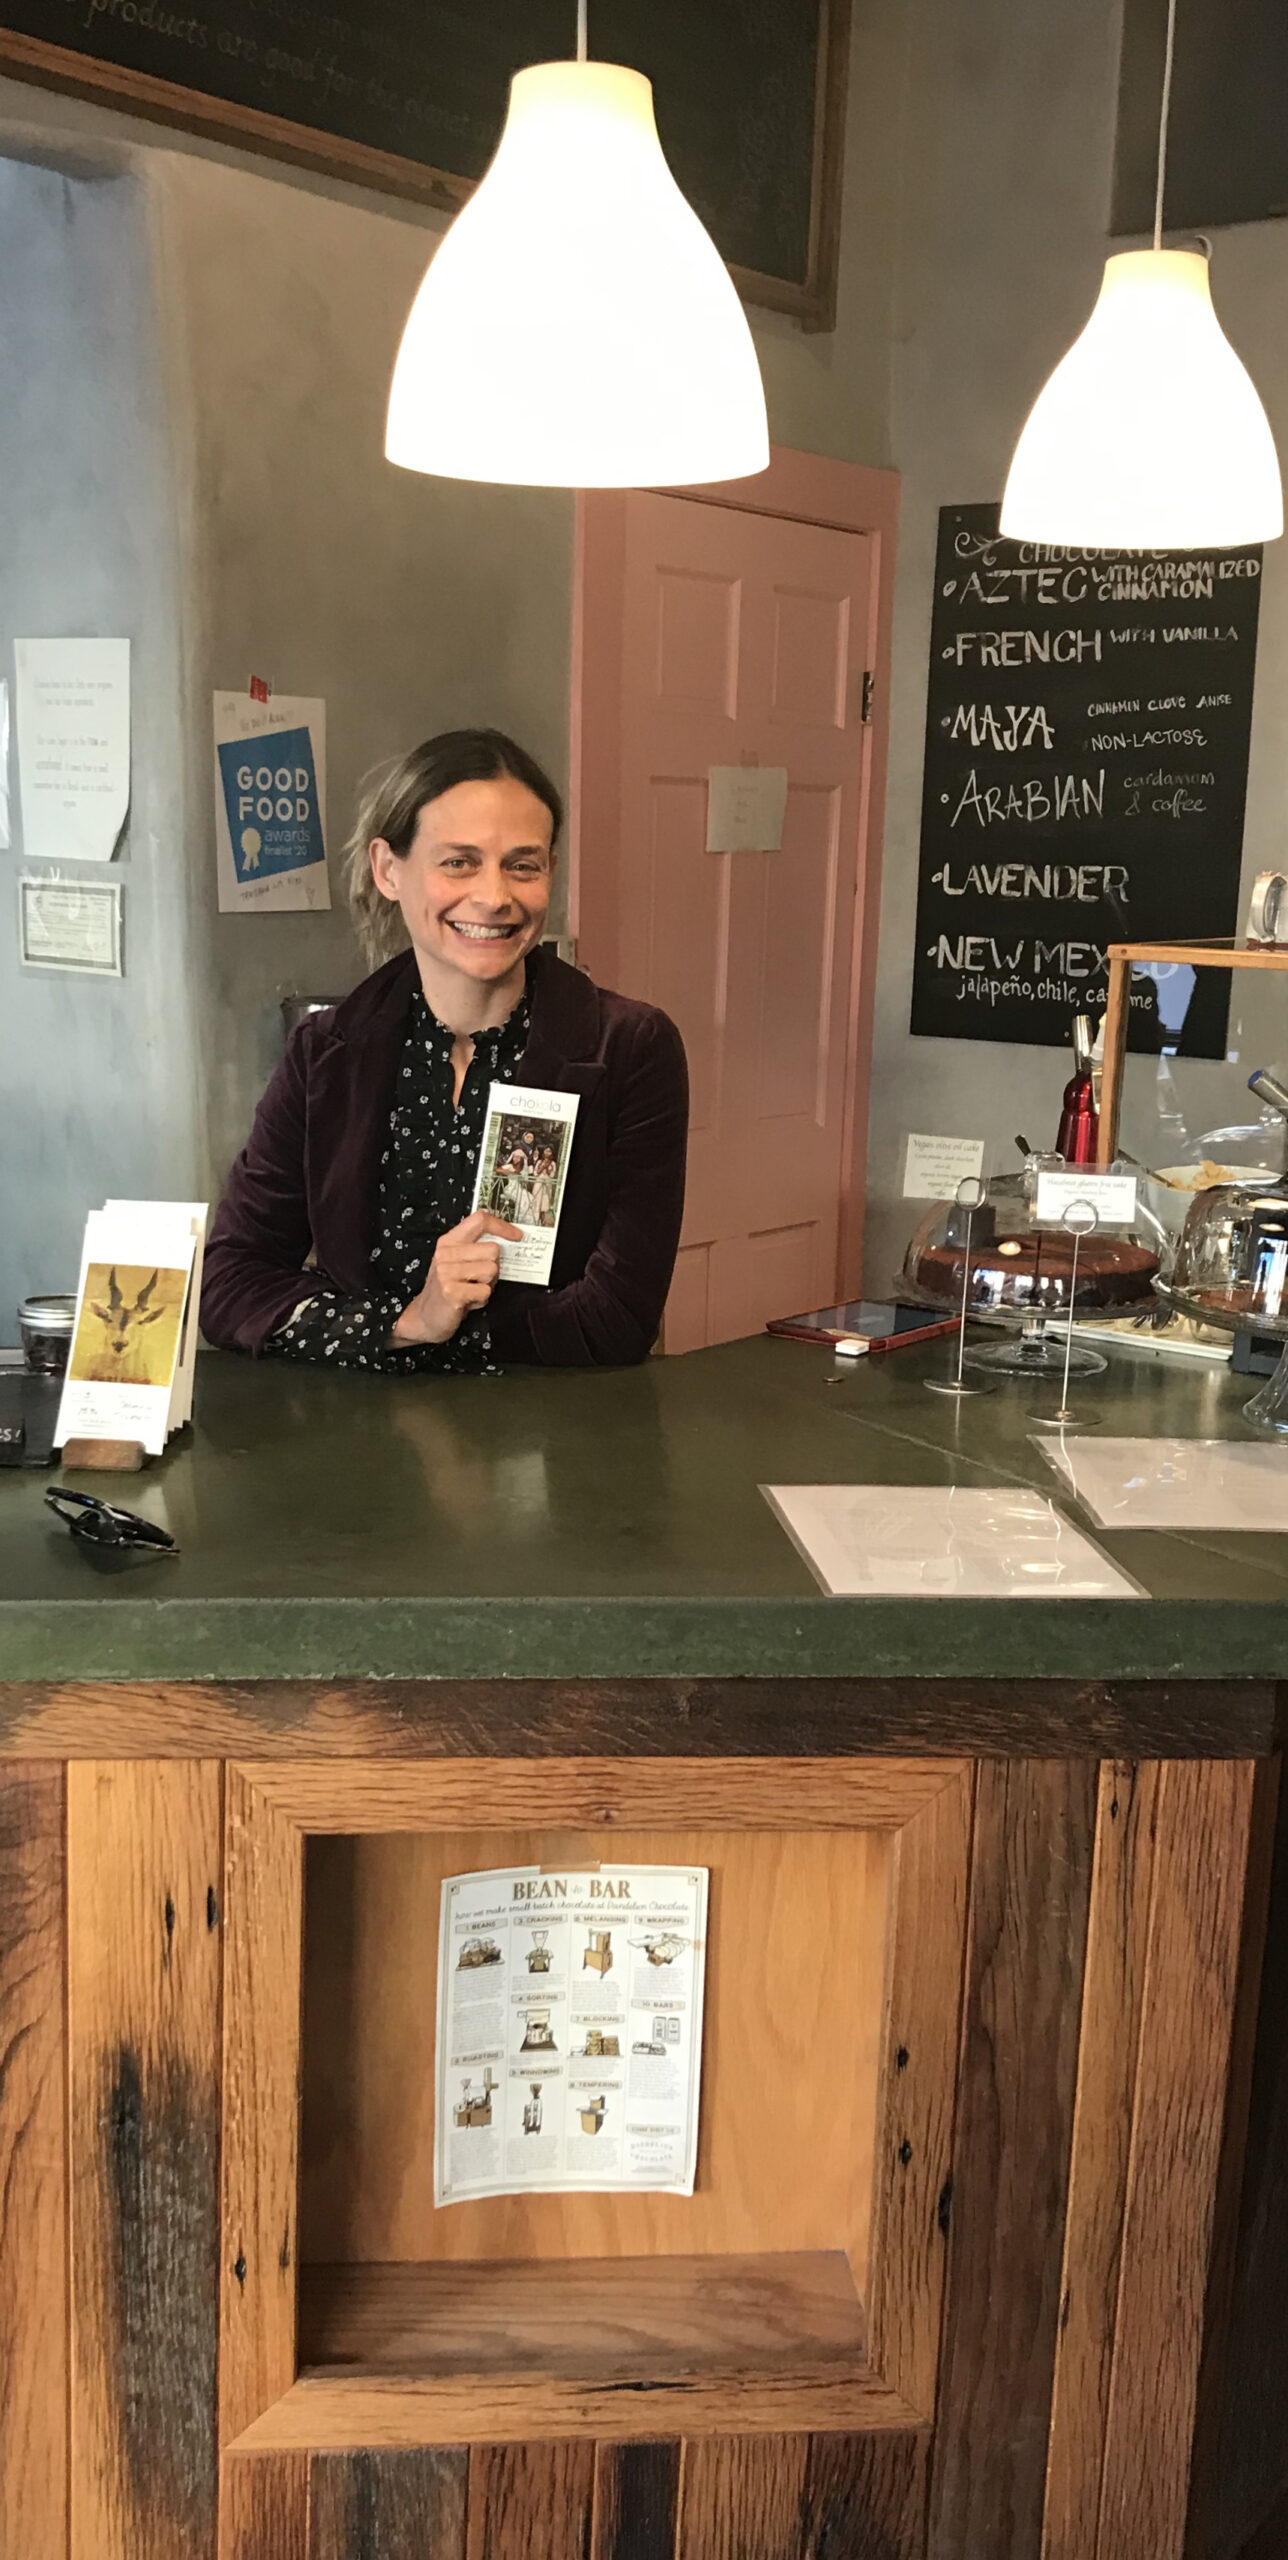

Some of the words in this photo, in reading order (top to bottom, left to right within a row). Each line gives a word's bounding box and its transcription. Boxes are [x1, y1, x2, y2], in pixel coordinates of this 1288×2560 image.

[83, 0, 208, 49] products
[960, 566, 1088, 604] AZTEC
[1091, 564, 1139, 583] WITH
[1097, 578, 1213, 601] CINNAMON
[956, 629, 1102, 666] FRENCH
[1110, 629, 1155, 643] WITH
[1162, 626, 1238, 642] VANILLA
[1147, 695, 1186, 711] CLOVE
[951, 703, 1055, 752] MAYA
[1091, 728, 1207, 752] NON-LACTOSE
[237, 766, 309, 792] GOOD
[239, 796, 309, 822] FOOD
[950, 768, 1105, 828] ARABIAN
[1151, 789, 1207, 819] coffee
[265, 826, 310, 842] awards
[942, 862, 1129, 902] LAVENDER
[937, 934, 1025, 972] NEW
[1034, 940, 1179, 981] MEXO
[509, 1095, 562, 1113] chola
[512, 1879, 568, 1901] BEAN
[589, 1879, 631, 1899] BAR
[486, 1905, 506, 1915] make
[508, 1902, 531, 1912] small
[533, 1901, 555, 1910] batch
[558, 1900, 594, 1910] chocolate
[649, 1900, 689, 1911] Chocolate
